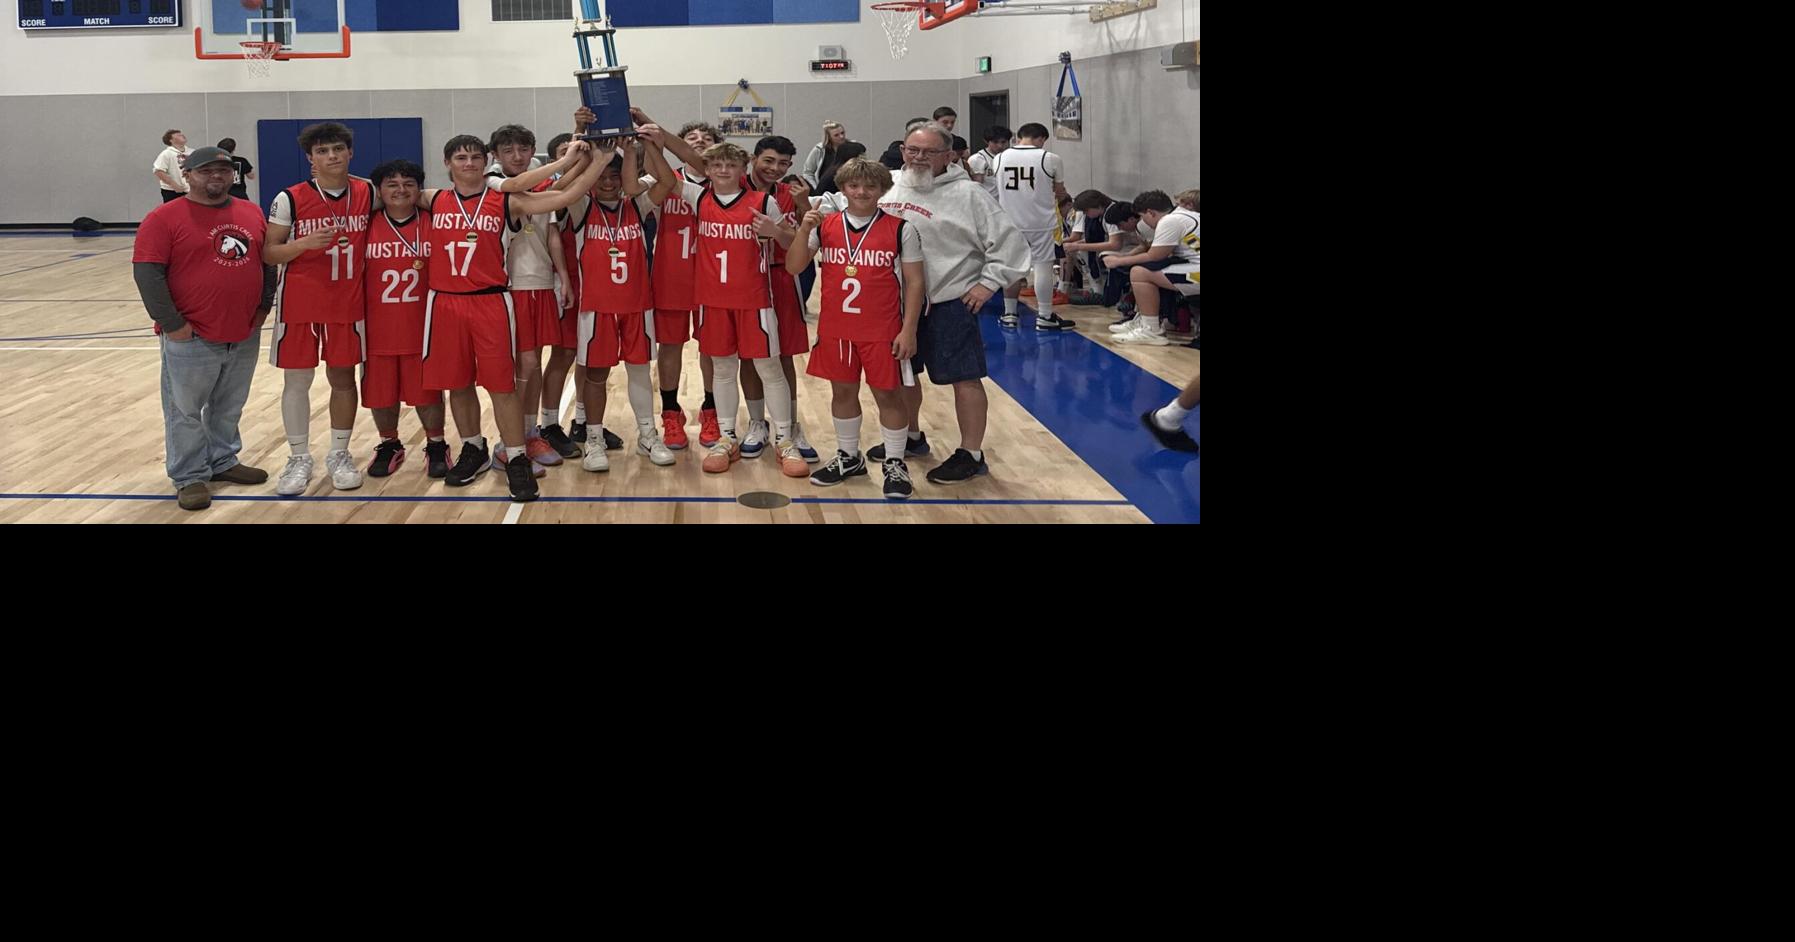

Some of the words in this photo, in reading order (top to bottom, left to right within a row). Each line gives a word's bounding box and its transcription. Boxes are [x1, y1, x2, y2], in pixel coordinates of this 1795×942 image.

[21, 19, 46, 27] SCORE
[148, 16, 174, 24] SCORE
[1004, 167, 1035, 190] 34
[664, 198, 693, 215] MUS
[587, 223, 641, 241] MUSANGS
[698, 221, 756, 240] MUSTANG
[325, 244, 354, 281] 11
[444, 241, 477, 277] 17
[611, 251, 628, 284] 5
[716, 250, 727, 284] 1
[822, 247, 894, 267] MUSANGS
[381, 268, 420, 304] 22
[841, 278, 862, 314] 2
